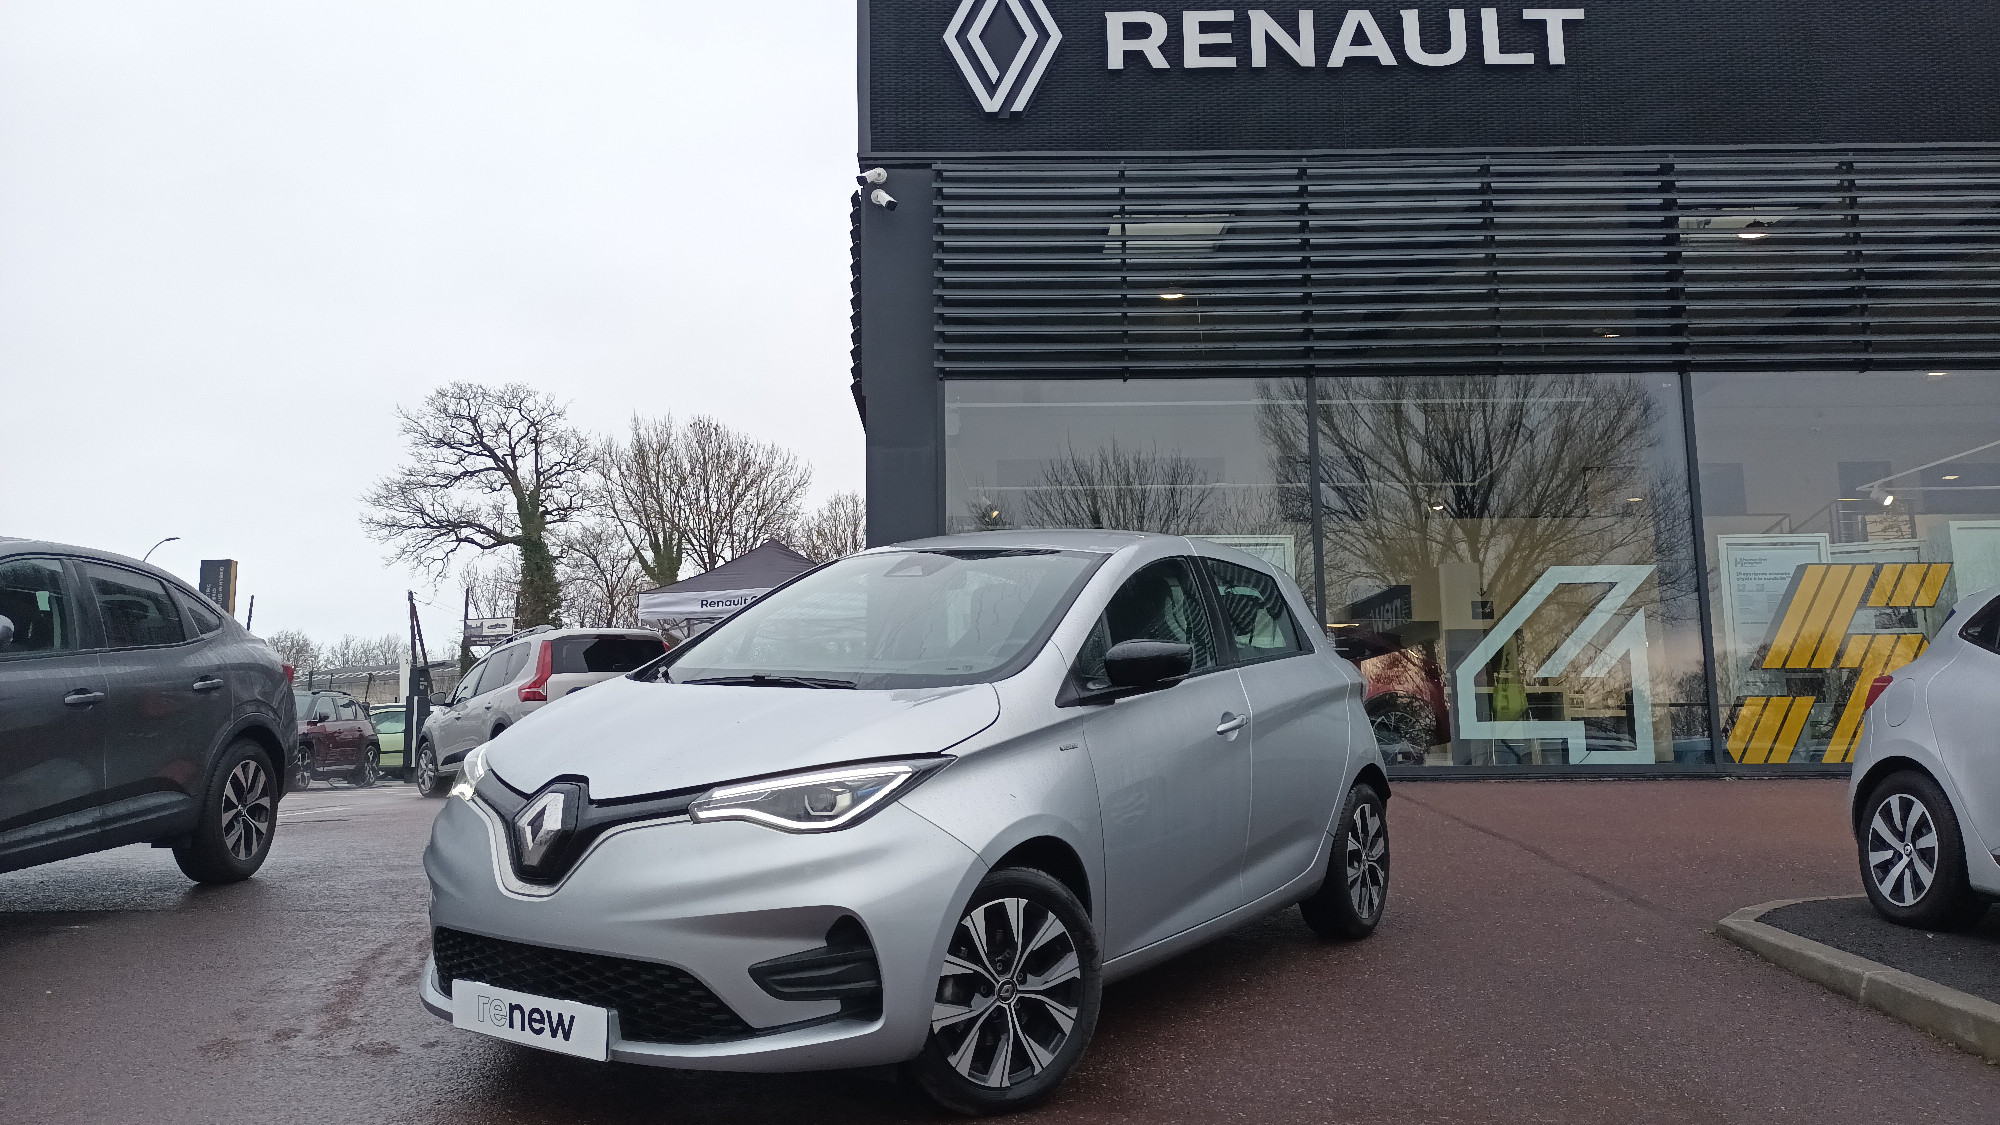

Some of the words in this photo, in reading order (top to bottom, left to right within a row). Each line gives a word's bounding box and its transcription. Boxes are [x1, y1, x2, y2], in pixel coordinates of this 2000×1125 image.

[1105, 8, 1585, 70] RENAULT
[700, 596, 749, 609] Renault
[477, 994, 576, 1042] renew
